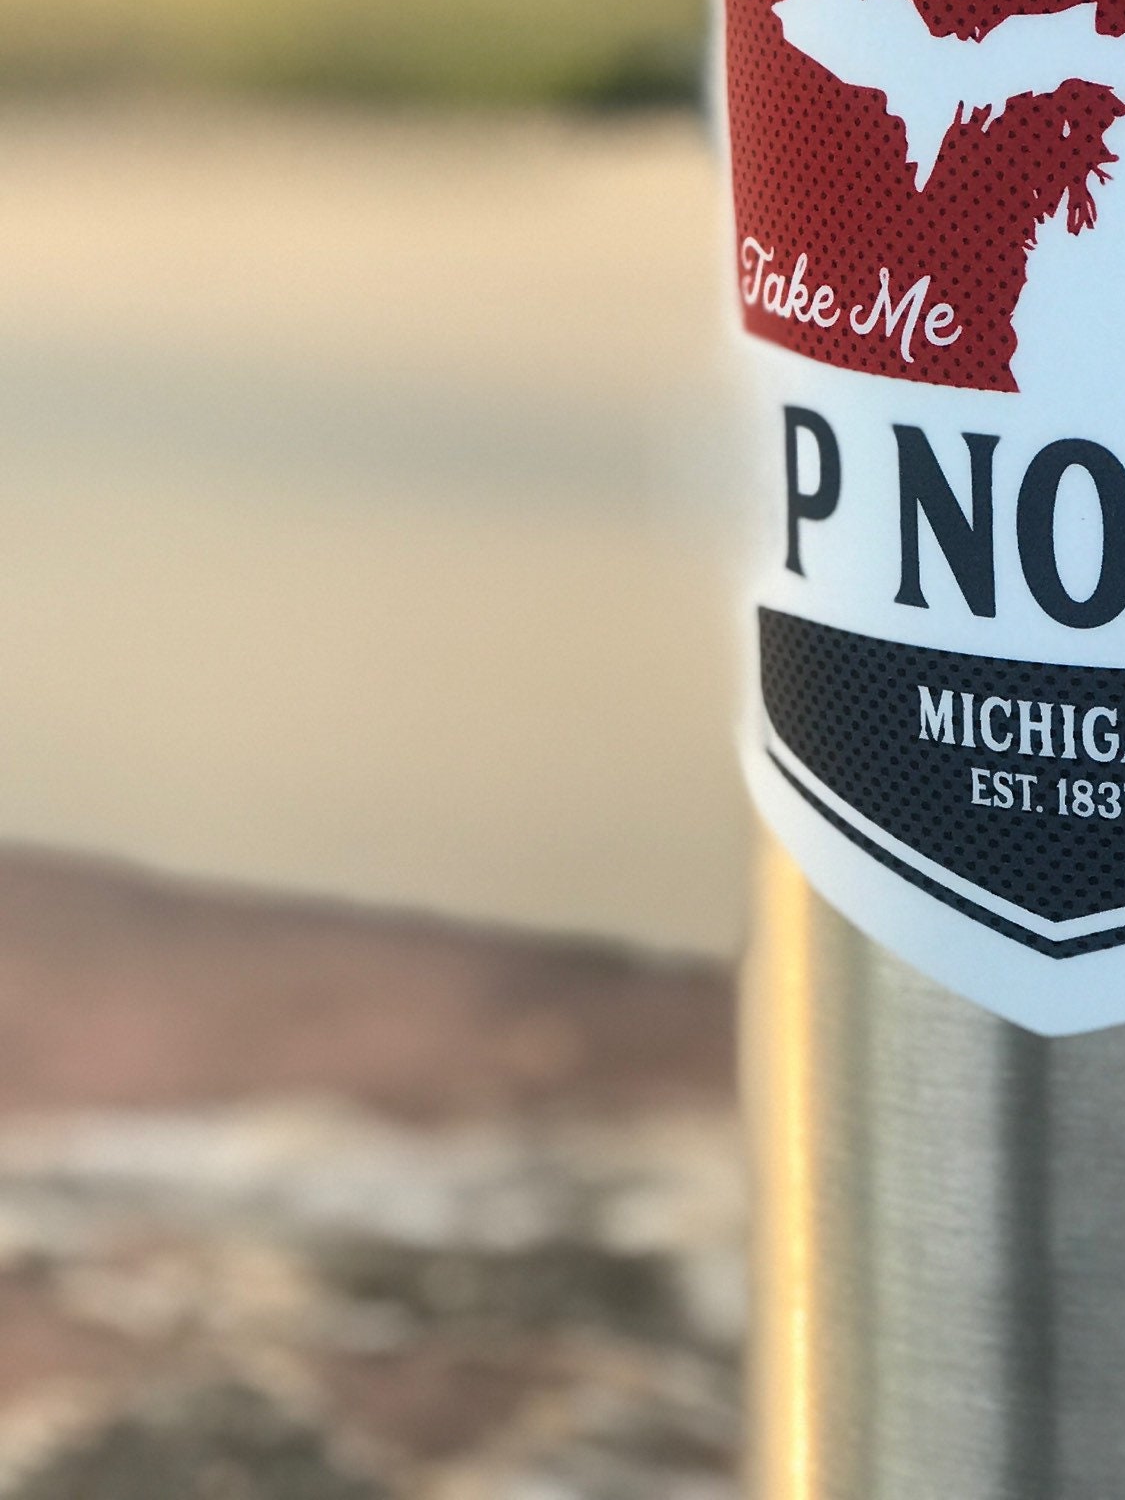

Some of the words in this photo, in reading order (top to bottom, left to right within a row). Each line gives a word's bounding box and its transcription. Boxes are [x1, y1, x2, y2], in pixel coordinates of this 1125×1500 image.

[741, 236, 841, 328] Take
[849, 266, 963, 363] Me
[971, 767, 1044, 813] EST.
